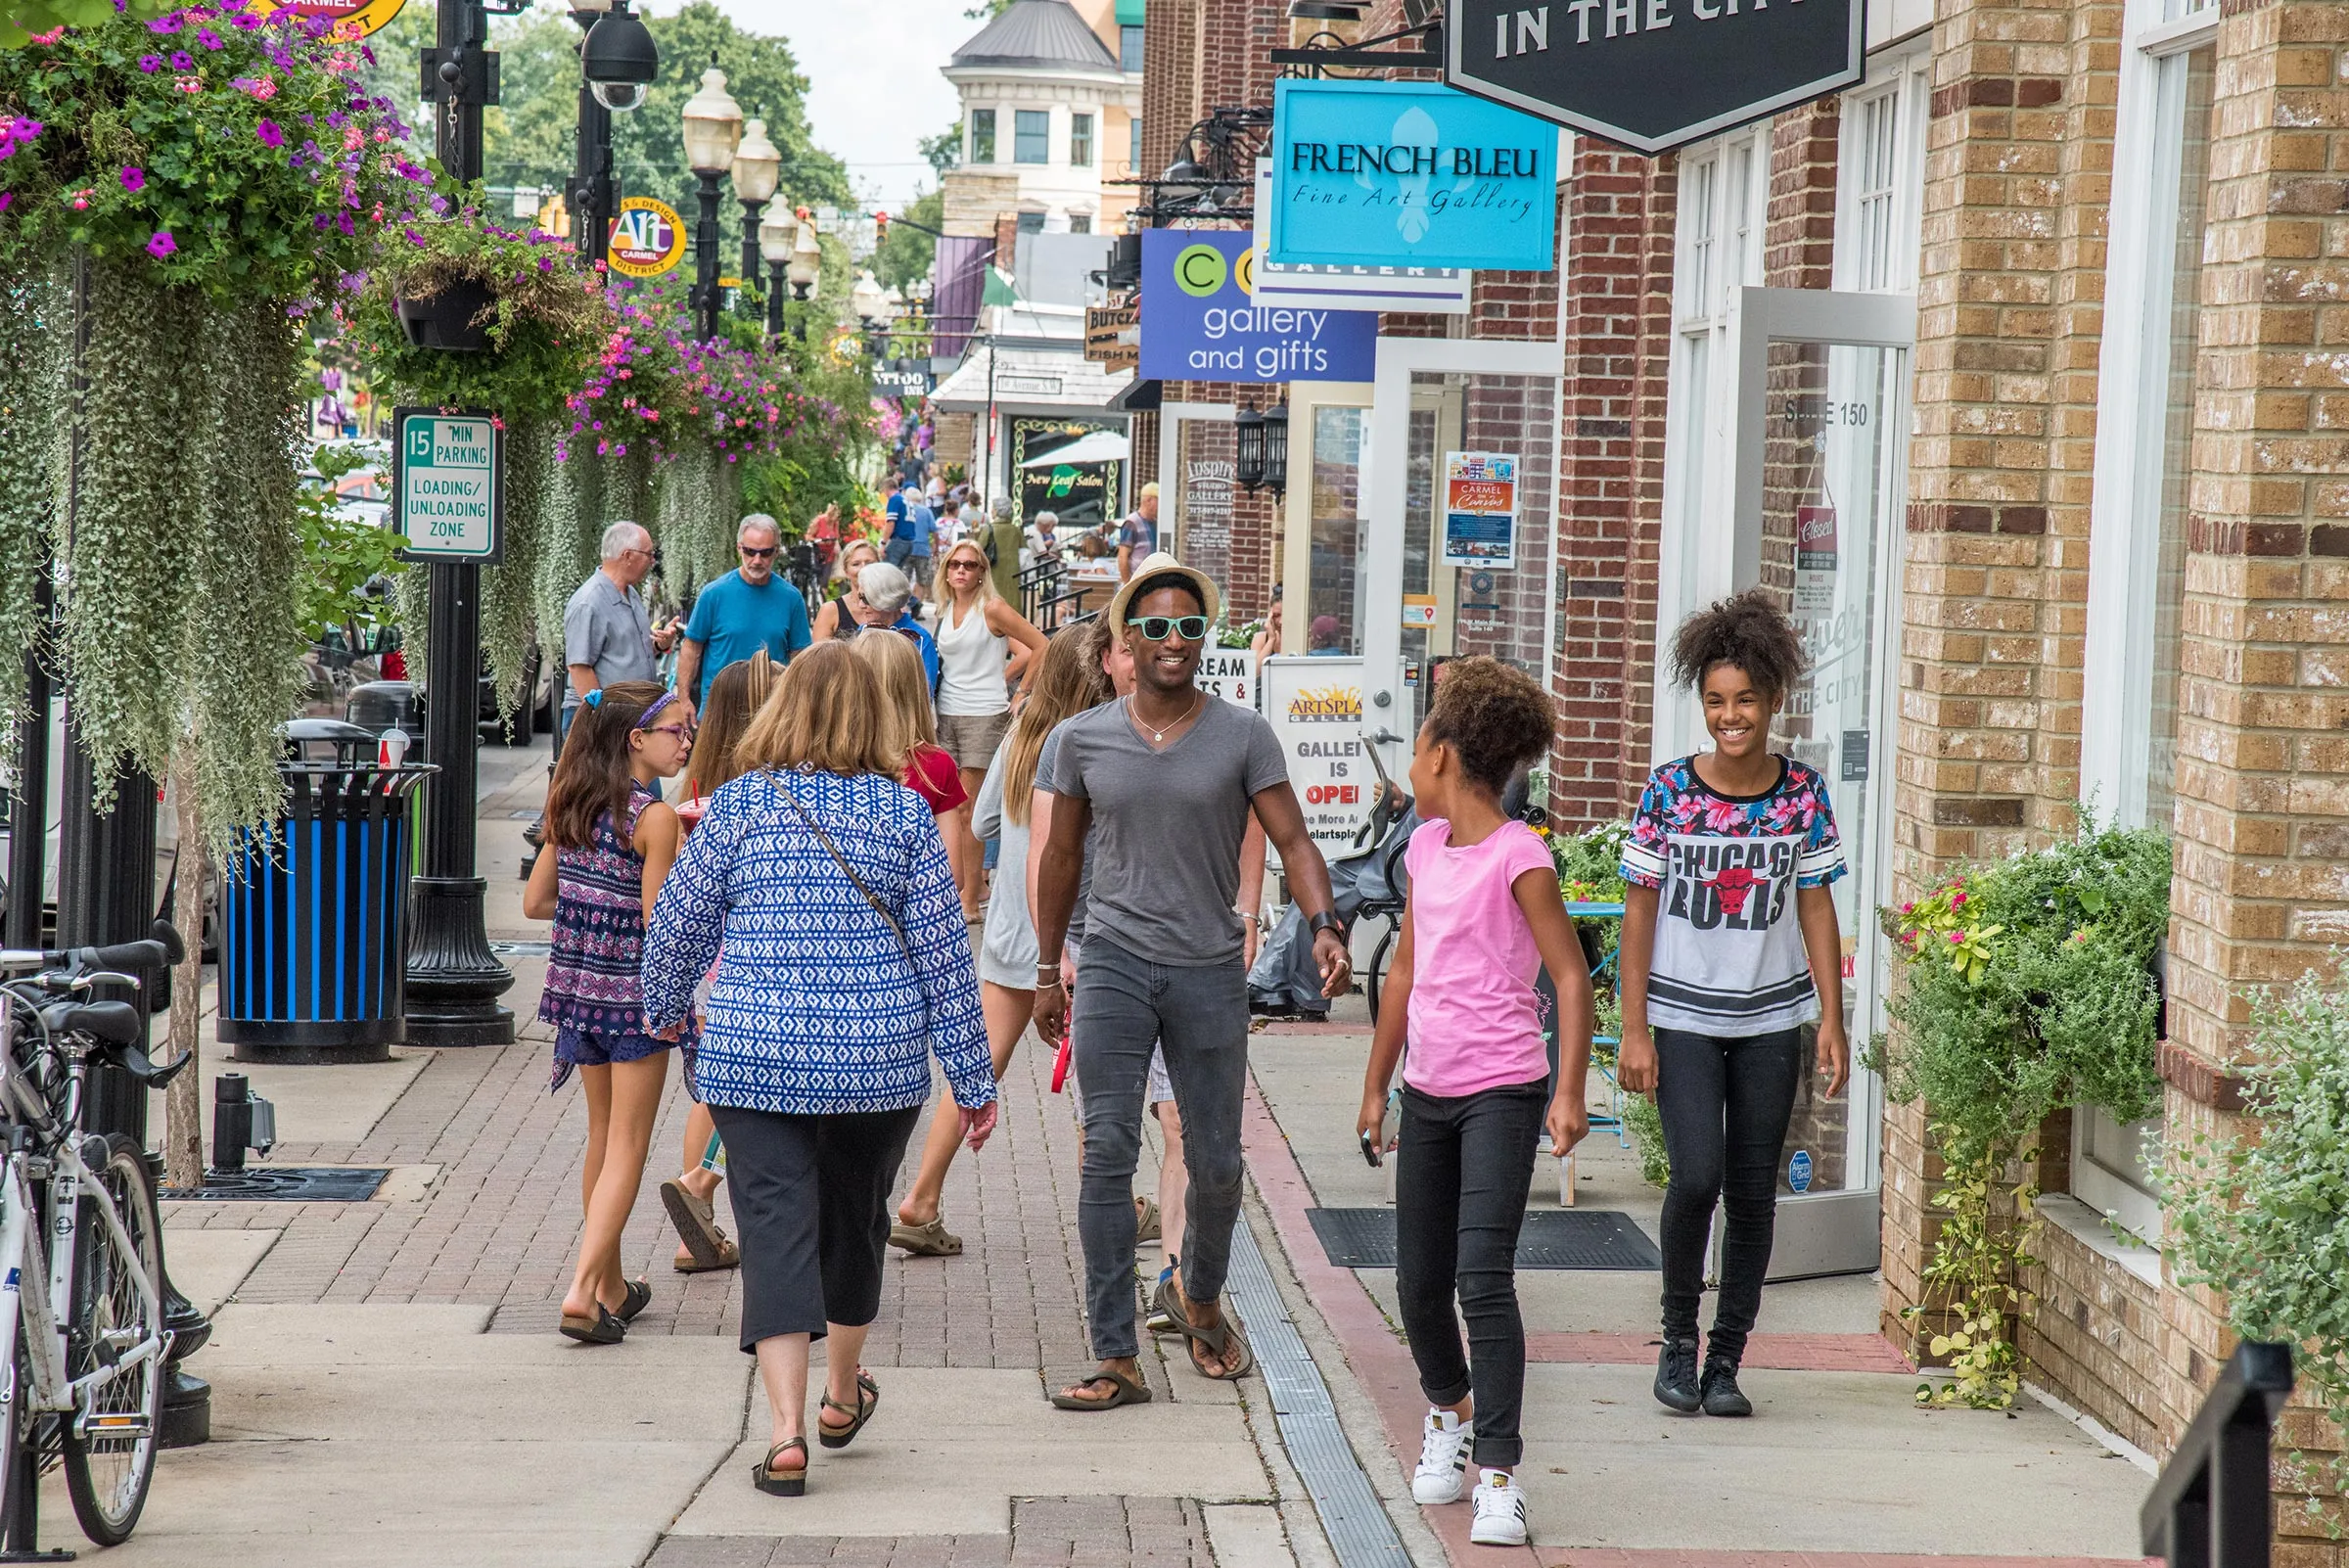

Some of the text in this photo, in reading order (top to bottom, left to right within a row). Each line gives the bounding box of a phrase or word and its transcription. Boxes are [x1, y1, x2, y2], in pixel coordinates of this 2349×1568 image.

[1495, 7, 1549, 59] IN
[1567, 0, 1674, 44] THE
[1291, 142, 1539, 178] FRENCH BLEU
[1292, 183, 1534, 222] Fine Art Gallery
[641, 200, 677, 224] DESIGN
[609, 210, 672, 254] Art
[621, 250, 659, 261] CARMEL
[615, 259, 666, 275] DISTRICT
[1204, 305, 1328, 341] gallery
[1088, 350, 1124, 360] FISH
[1188, 340, 1328, 378] and gifts
[1012, 378, 1040, 391] Avenue
[1840, 402, 1867, 427] 150
[451, 425, 473, 442] MIN
[409, 430, 430, 456] 15
[437, 445, 486, 464] PARKING
[414, 479, 482, 496] LOADING/
[1026, 473, 1104, 489] New Leaf Salon
[1460, 484, 1501, 494] CARMEL
[1186, 491, 1233, 501] GALLERY
[1456, 494, 1503, 509] Canvas
[410, 500, 486, 518] UNLOADING
[430, 522, 466, 537] ZONE
[1800, 512, 1834, 543] Closed
[1194, 657, 1246, 677] REAM
[1199, 680, 1246, 699] TS &
[1789, 673, 1861, 715] THE CITY
[1290, 698, 1362, 714] ARTSPLA
[1330, 761, 1349, 778] IS
[1318, 813, 1346, 824] More
[1668, 841, 1801, 879] CHICAGO
[1796, 1169, 1810, 1180] Grid
